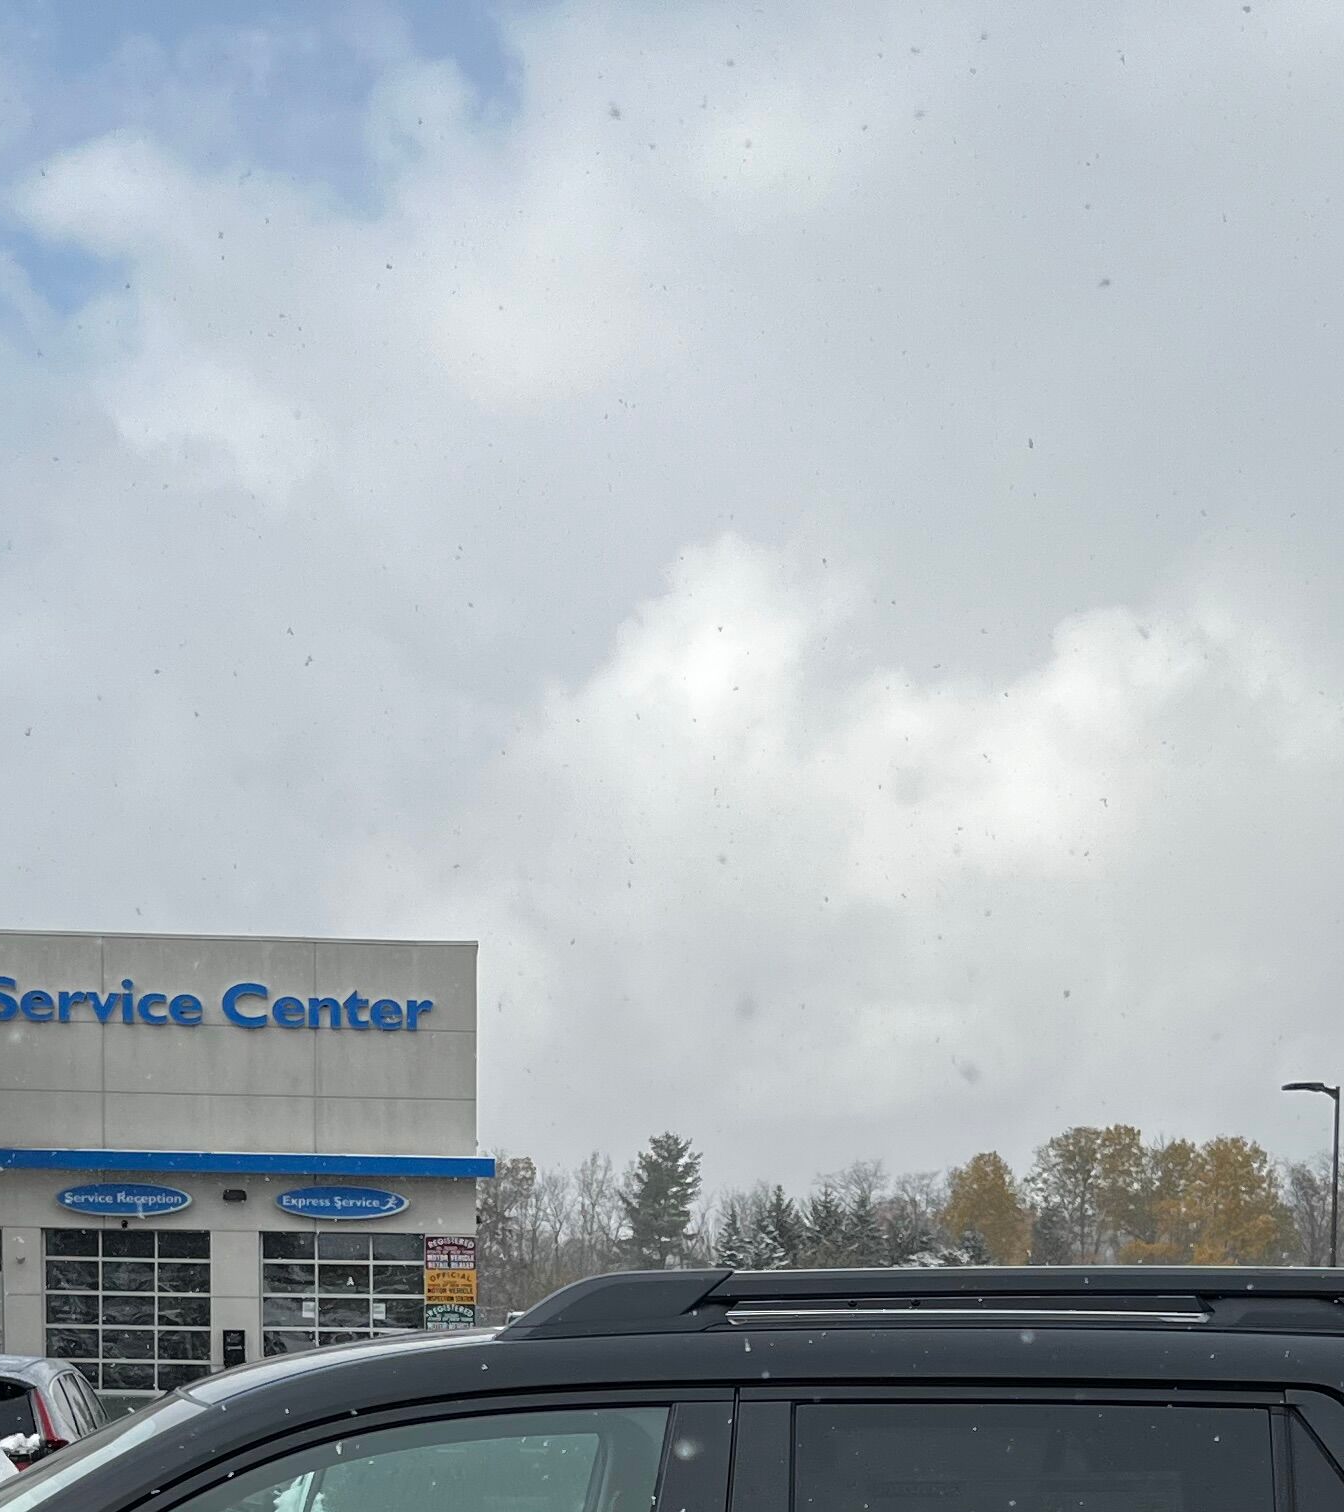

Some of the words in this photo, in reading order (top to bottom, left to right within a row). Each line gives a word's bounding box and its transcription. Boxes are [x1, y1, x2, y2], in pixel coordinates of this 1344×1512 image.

[222, 982, 434, 1031] Center
[64, 1192, 113, 1204] Service
[117, 1191, 182, 1206] Reception
[282, 1195, 330, 1208] Express
[334, 1196, 380, 1208] Service
[427, 1237, 475, 1249] REGISTERED
[430, 1271, 472, 1282] OFFICIAL
[427, 1304, 474, 1317] REGISTERED
